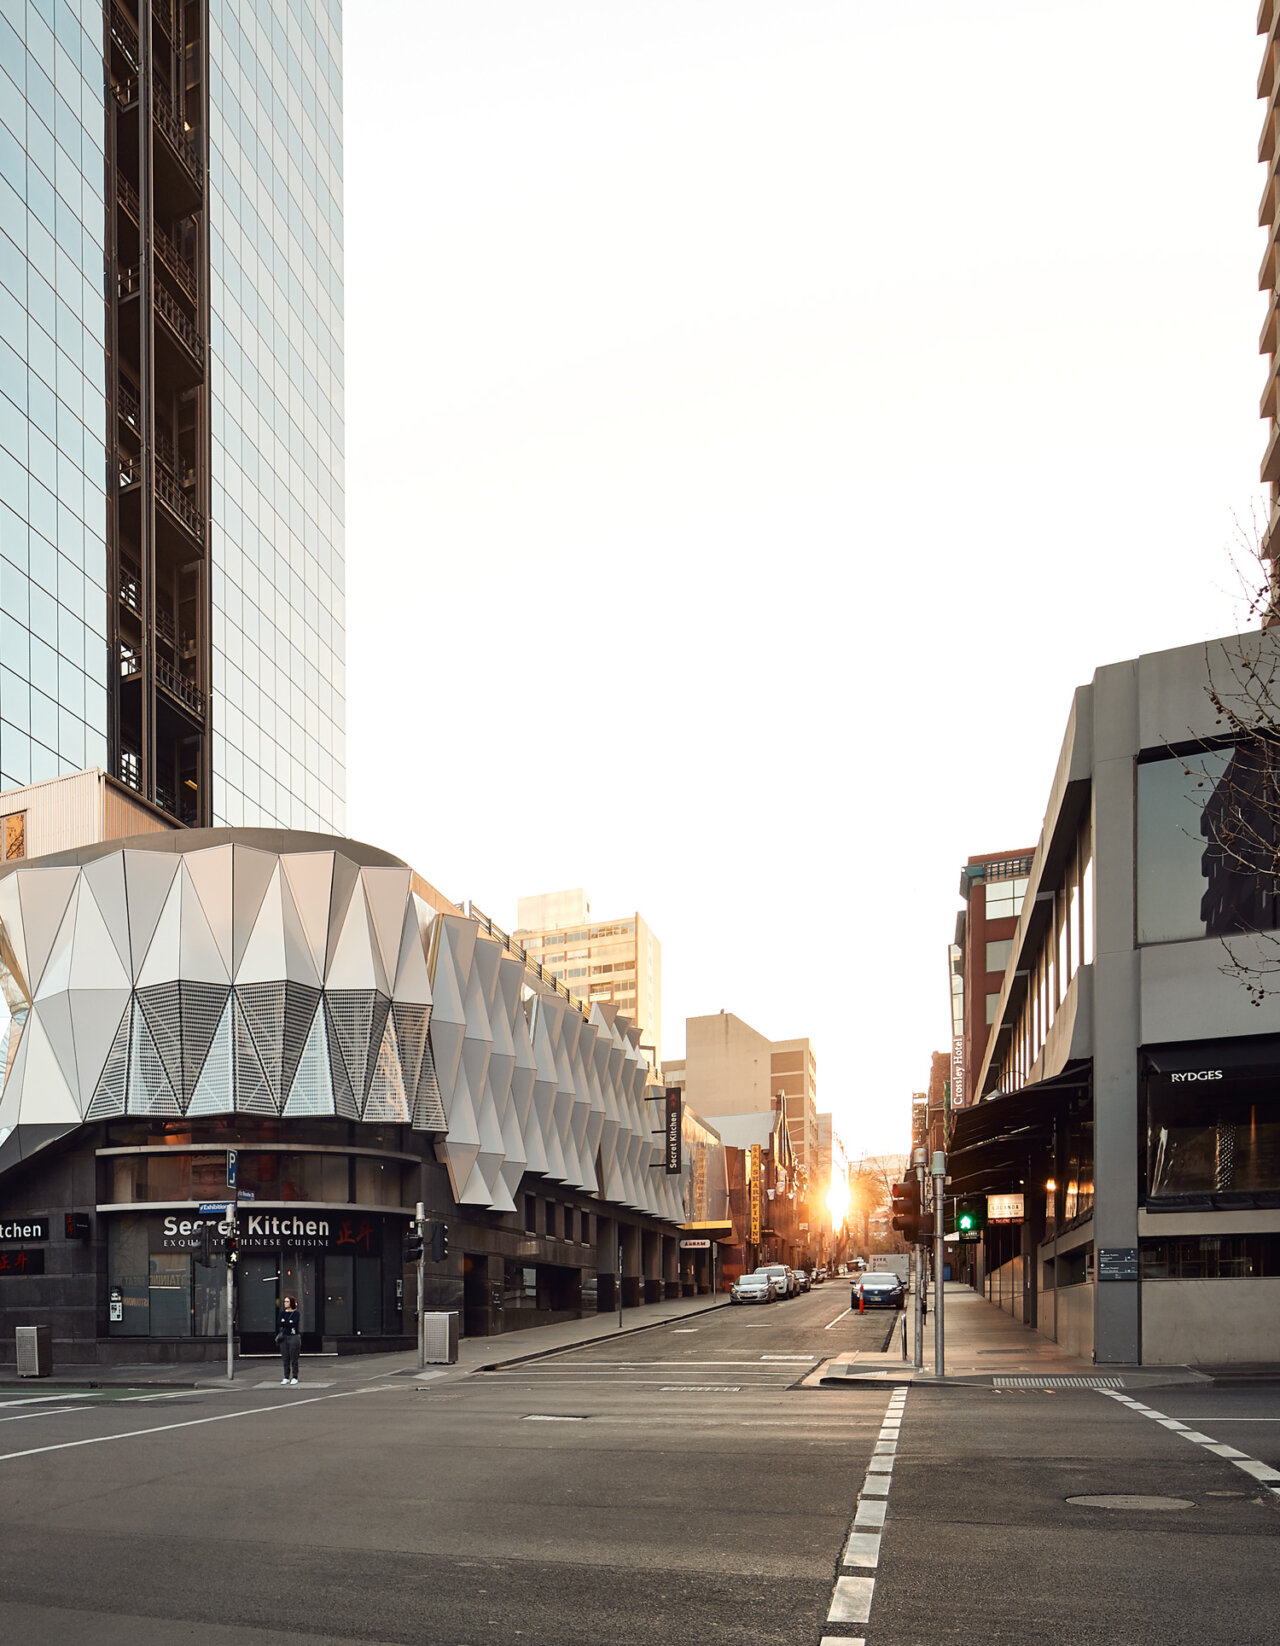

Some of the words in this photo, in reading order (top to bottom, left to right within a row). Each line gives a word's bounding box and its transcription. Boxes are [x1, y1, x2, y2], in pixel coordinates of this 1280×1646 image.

[953, 1038, 963, 1064] Hotel
[953, 1066, 965, 1105] Crossley
[1171, 1070, 1223, 1082] RYDGES
[229, 1153, 236, 1169] P
[248, 1215, 329, 1235] Kitchen
